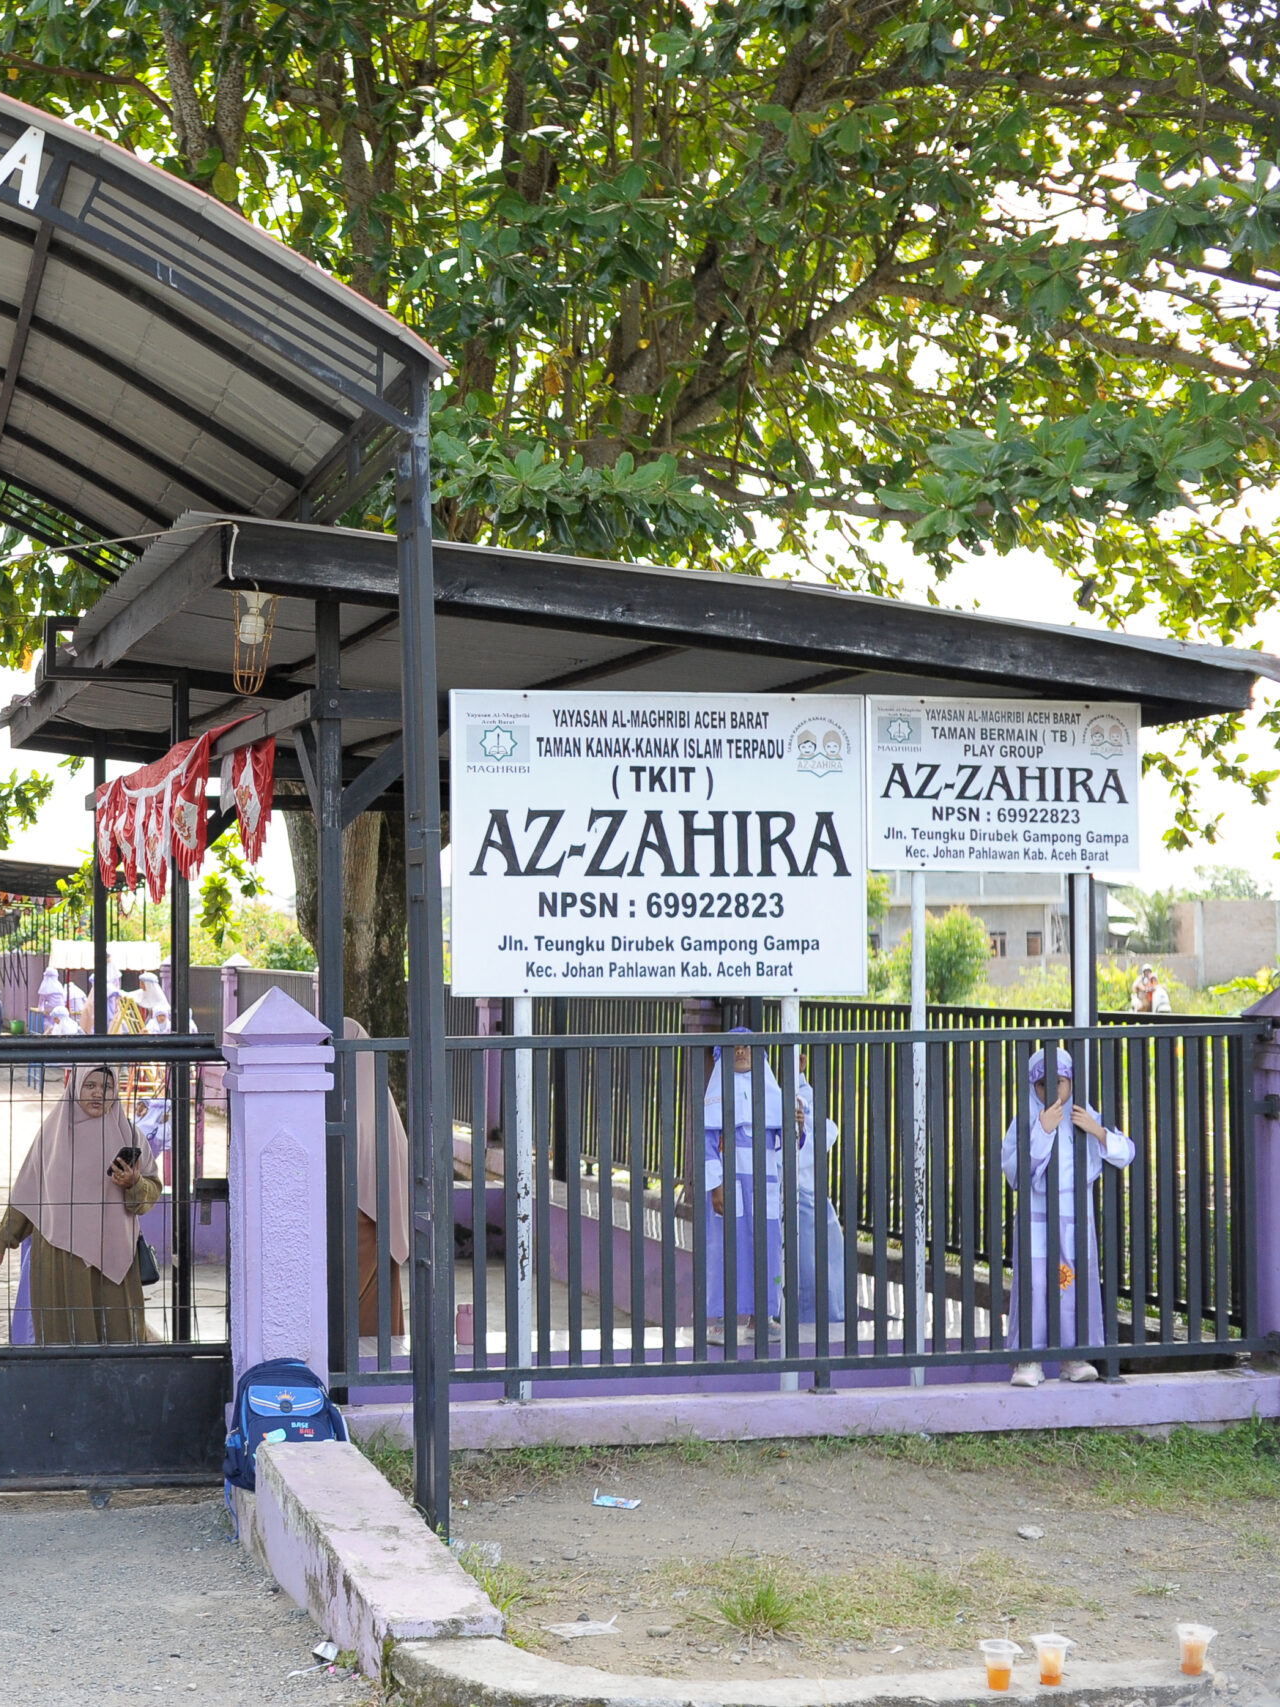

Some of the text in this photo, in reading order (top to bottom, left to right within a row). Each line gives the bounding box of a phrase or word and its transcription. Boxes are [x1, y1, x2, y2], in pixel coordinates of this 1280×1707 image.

[553, 709, 769, 729] YAYASAN AL-MAGHRIBI ACEH BARAT
[925, 708, 965, 722] YAYASAN
[968, 710, 1024, 724] AL-MAGHRIBI
[1027, 711, 1051, 725] ACEH
[1053, 712, 1081, 725] BARAT
[931, 726, 975, 740] TAMAN
[980, 727, 1037, 742] BERMAIN
[1050, 730, 1067, 742] TB
[536, 737, 784, 759] TAMAN KANAK-KANAK ISLAM TERPADU
[964, 744, 1043, 758] PLAY GROUP
[466, 765, 530, 773] MAGHRIBI
[630, 766, 696, 792] TKIT
[880, 763, 1128, 804] AZ-ZAHIRA
[932, 806, 979, 822] NPSN
[997, 808, 1080, 824] 69922823
[469, 808, 852, 878] AZ-ZAHIRA
[884, 827, 1128, 847] Jln. Teungku Dirubek Gampong Gampa
[906, 845, 1109, 861] Kec. Johan Pahlawan Kab. Aceh Barat
[539, 892, 618, 918] NPSN
[647, 892, 784, 918] 69922823
[498, 935, 819, 956] Jln. Teungku Dirubek Gampong Gampa
[526, 961, 793, 978] Kec. Johan Pahlawan Kab. Aceh Barat
